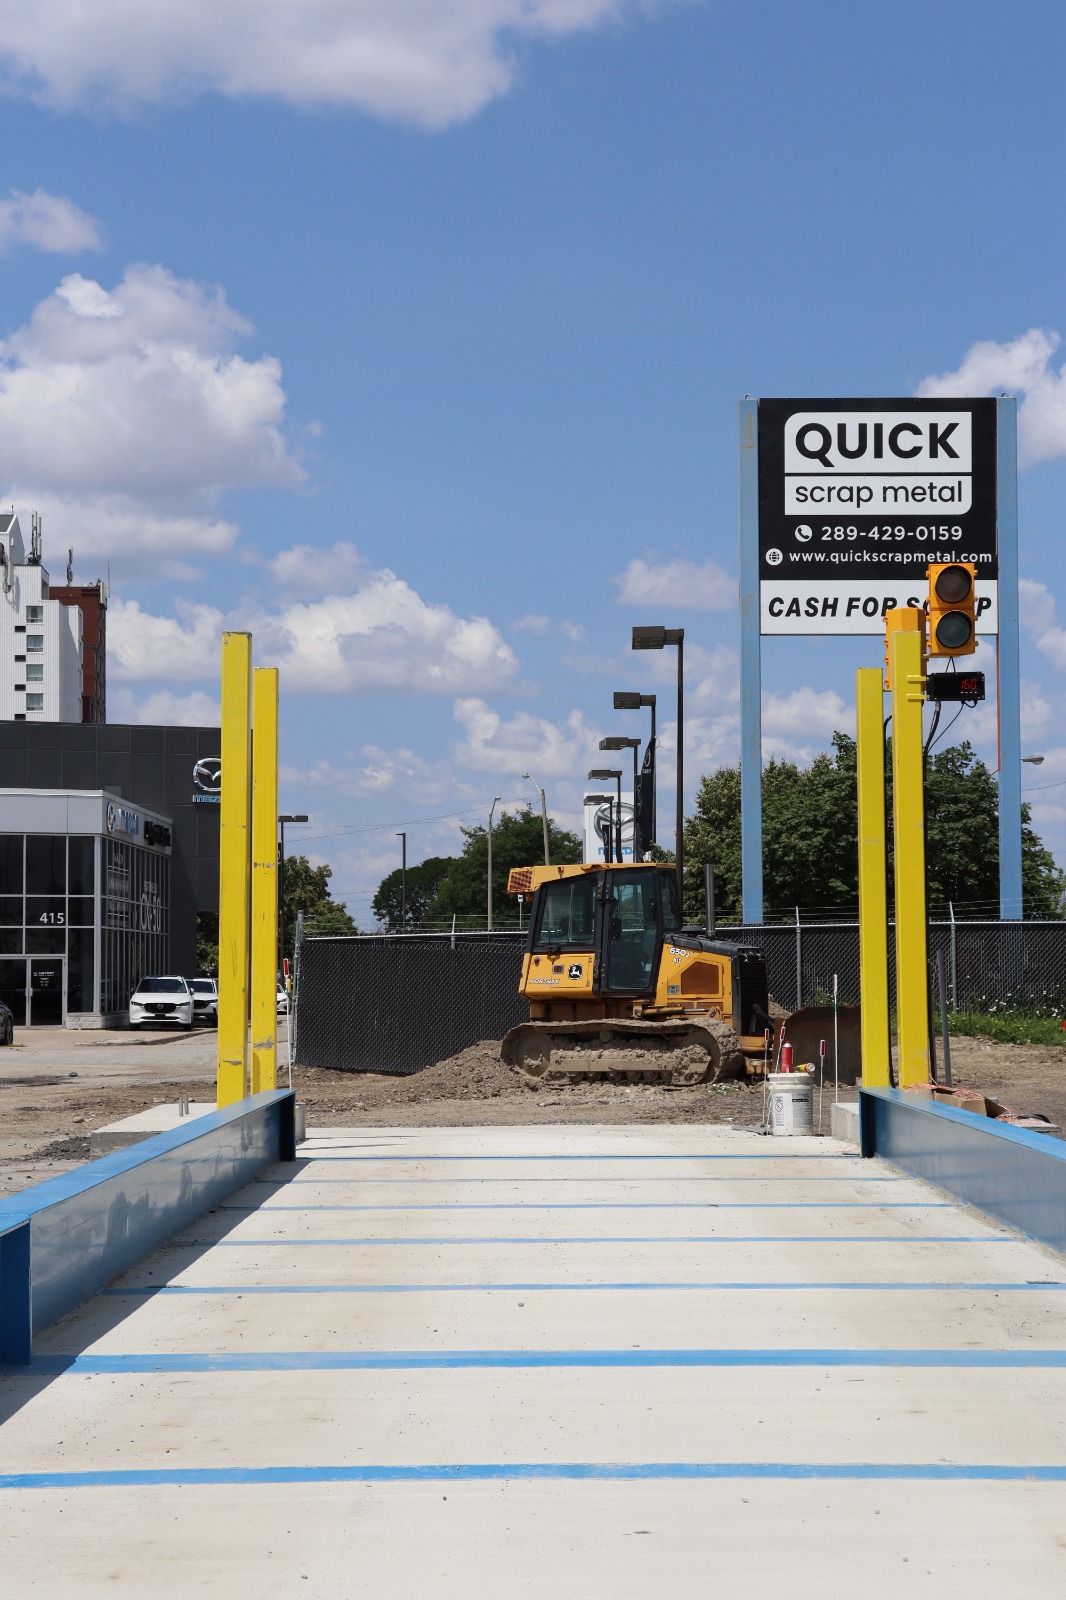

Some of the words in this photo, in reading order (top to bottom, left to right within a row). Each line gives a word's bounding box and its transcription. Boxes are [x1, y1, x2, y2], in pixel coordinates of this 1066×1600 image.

[795, 422, 961, 468] QUICK
[795, 485, 873, 508] scrap
[882, 480, 962, 503] metal
[821, 526, 963, 541] 289-429-0159
[789, 550, 992, 564] www.quickscrapmetal.com
[768, 596, 839, 617] CASH
[846, 596, 898, 617] FOR
[39, 912, 65, 924] 415
